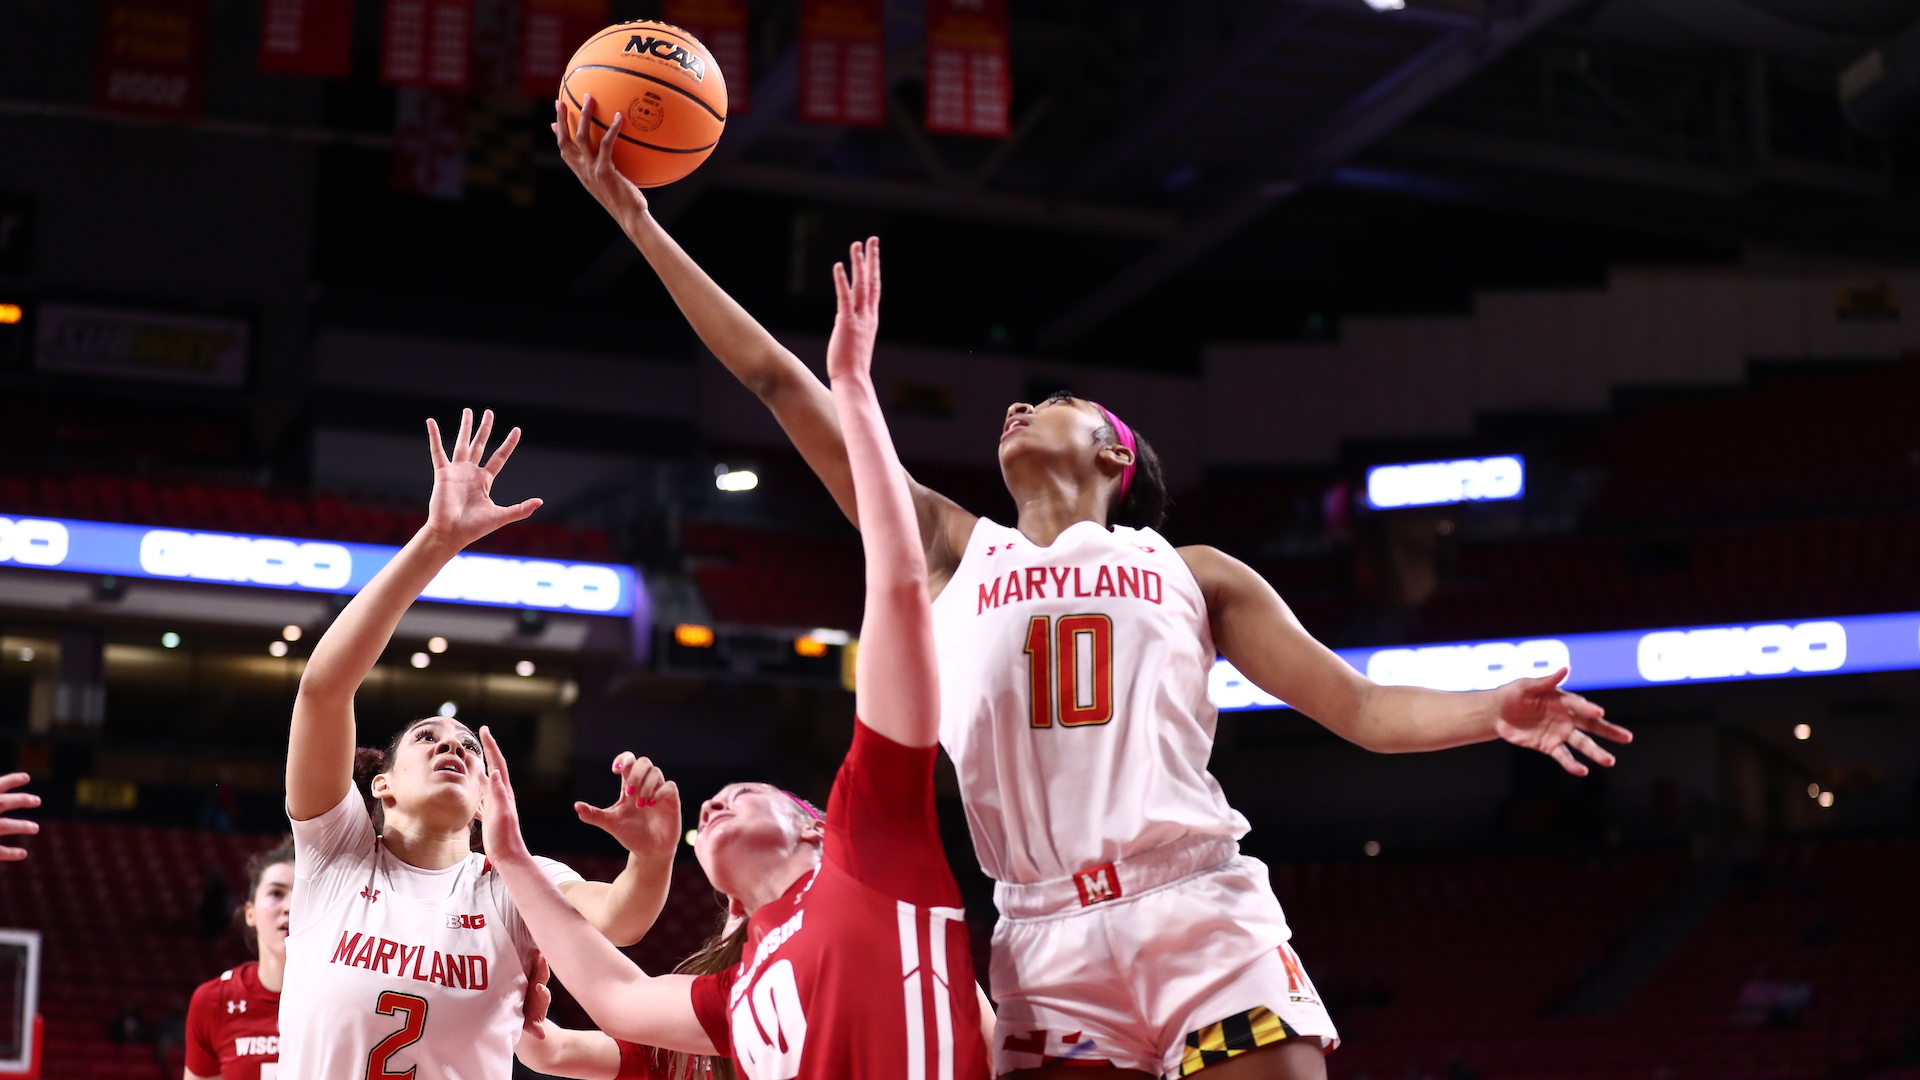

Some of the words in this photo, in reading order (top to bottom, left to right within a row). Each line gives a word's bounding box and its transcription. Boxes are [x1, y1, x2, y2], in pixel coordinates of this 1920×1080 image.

[620, 53, 657, 63] OFFICIAL
[622, 35, 706, 82] NCAA
[140, 529, 352, 590] GEICO
[977, 565, 1162, 616] MARYLAND
[1023, 613, 1113, 729] 10
[1637, 621, 1847, 682] GEICO
[1081, 868, 1113, 902] M
[330, 930, 488, 991] MARYLAND
[235, 1035, 280, 1057] WISC
[365, 990, 428, 1080] 2
